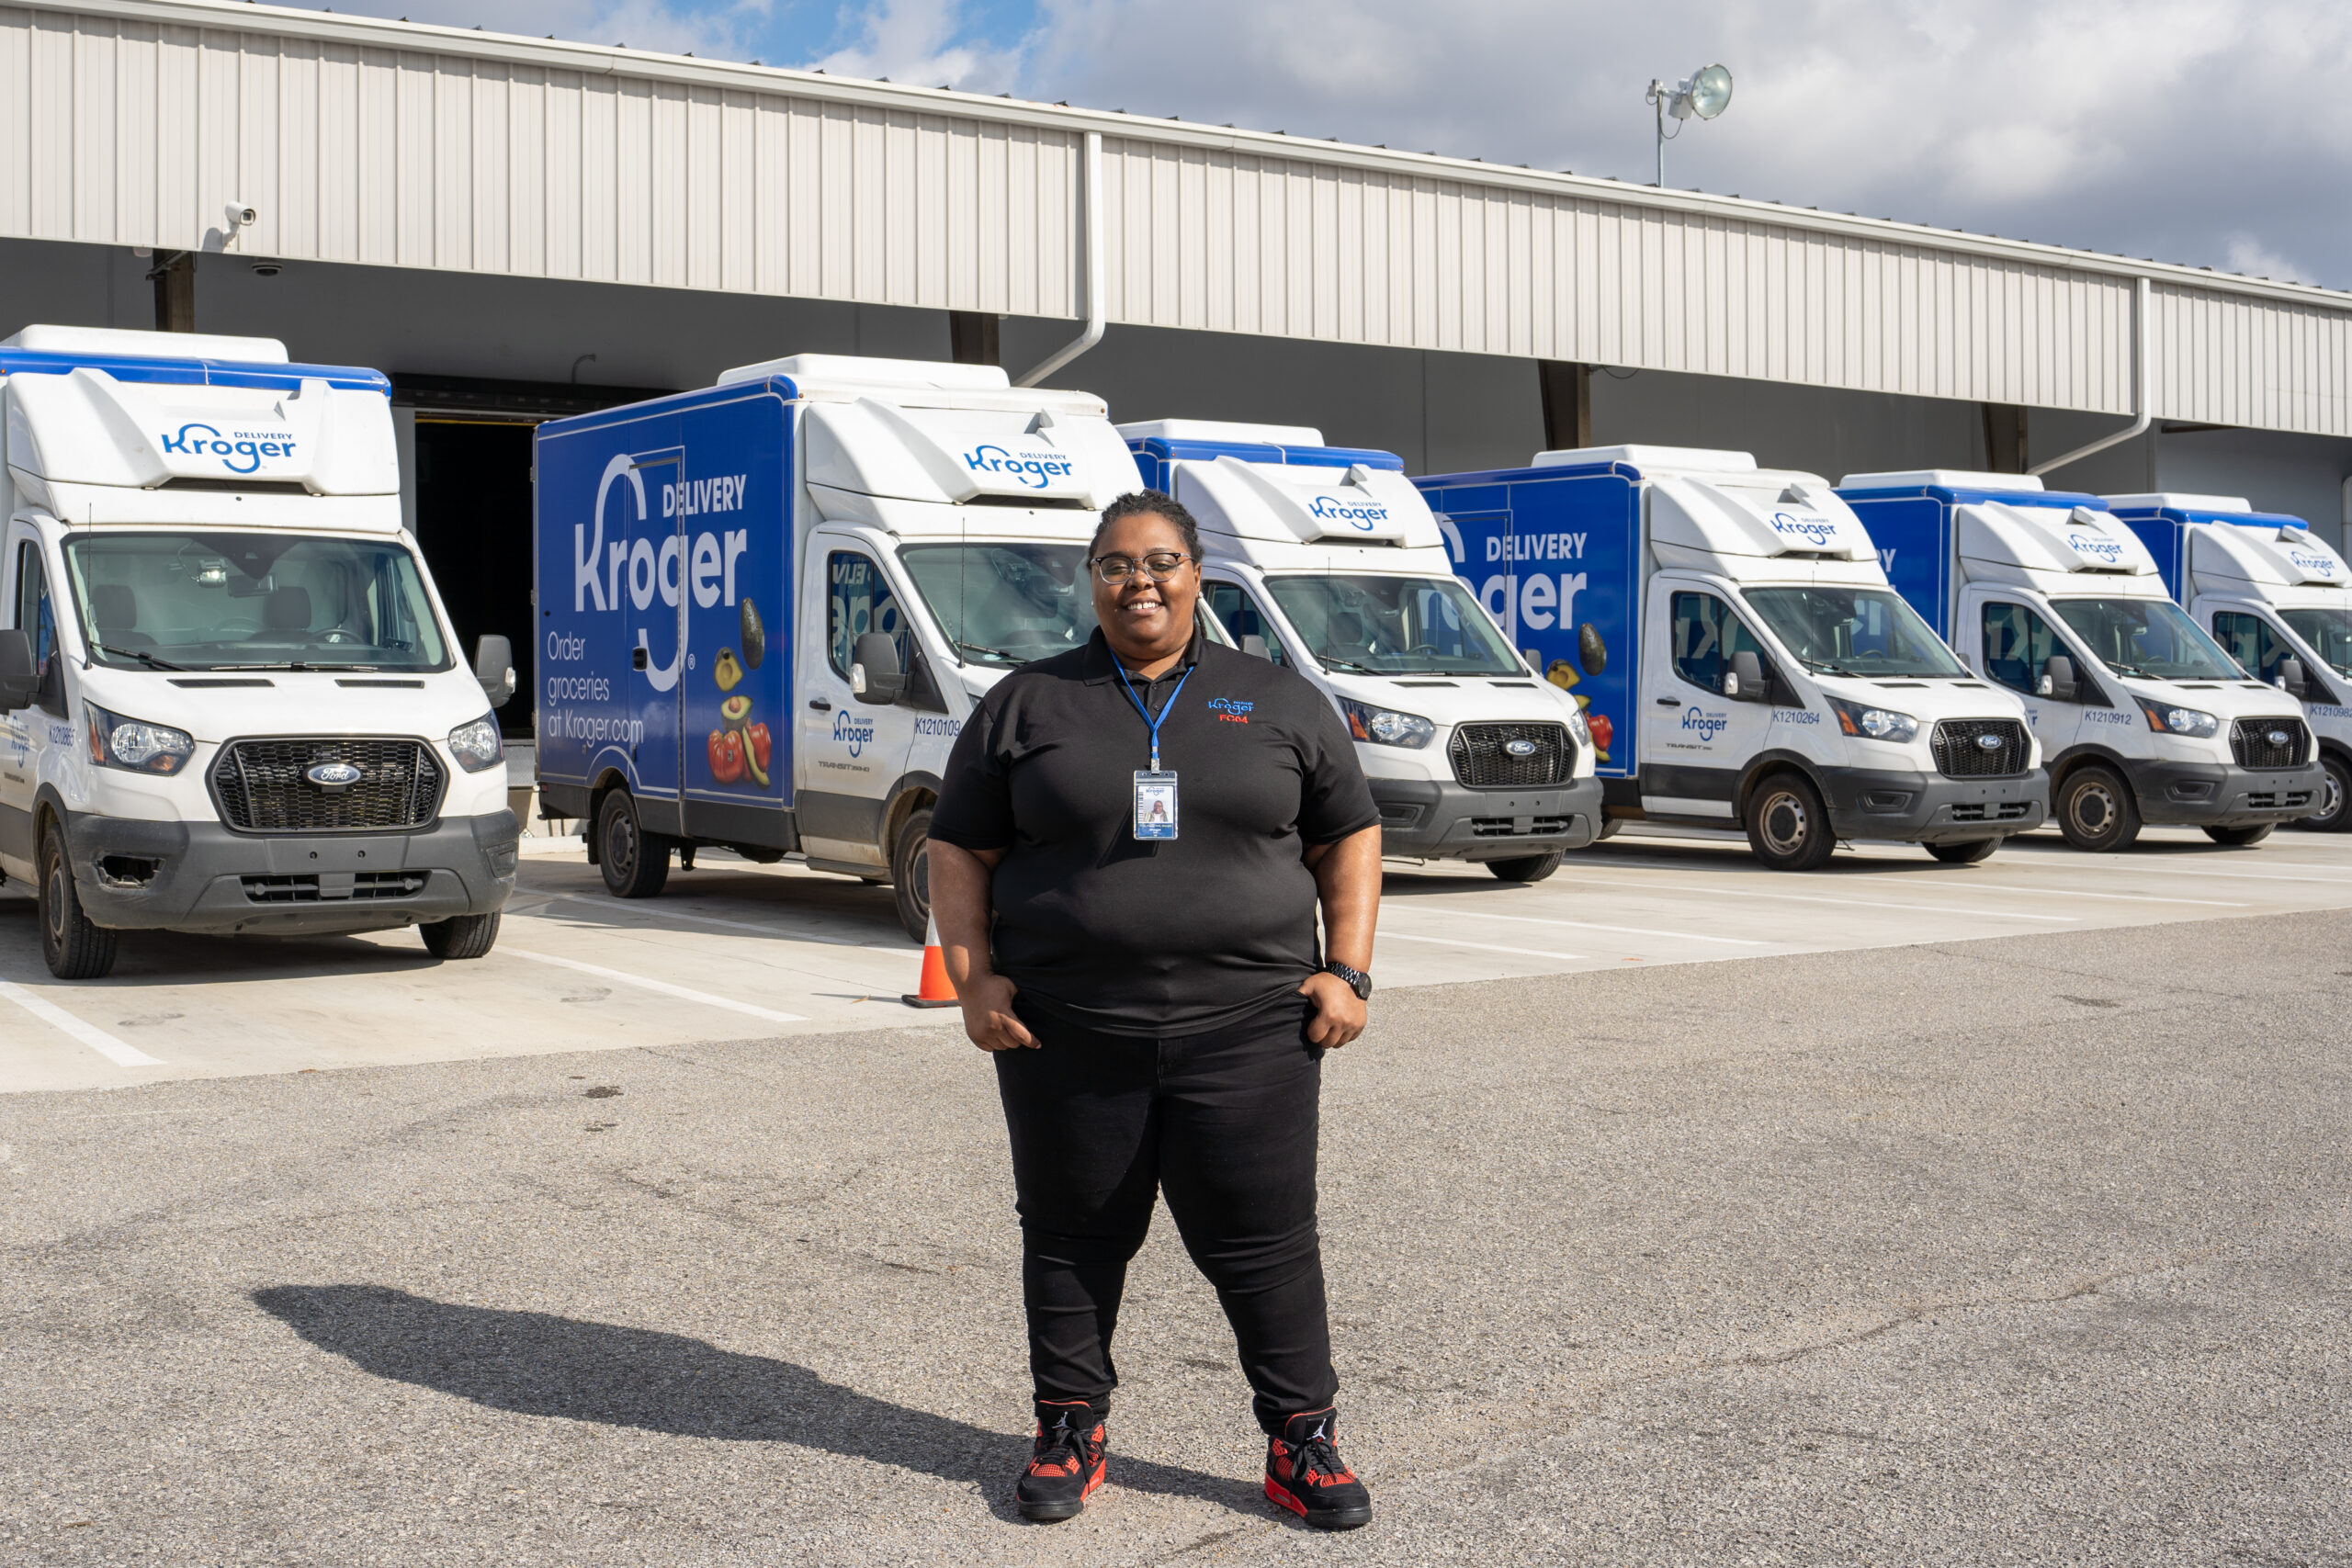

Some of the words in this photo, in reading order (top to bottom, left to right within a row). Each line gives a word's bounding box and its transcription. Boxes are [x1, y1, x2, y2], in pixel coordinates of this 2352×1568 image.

[161, 423, 297, 474] Kroger
[233, 431, 293, 440] DELIVERY
[963, 445, 1073, 489] Kroger
[1019, 452, 1067, 460] DELIVERY
[662, 474, 747, 518] DELIVERY
[1308, 496, 1388, 531] Kroger
[1770, 513, 1837, 546] Kroger
[1486, 532, 1588, 562] DELIVERY
[2066, 534, 2123, 563] Kroger
[574, 453, 748, 692] Kroger
[548, 631, 585, 660] Order
[548, 671, 610, 706] groceries
[1207, 697, 1255, 715] Kroger
[1219, 714, 1249, 724] FC04
[1773, 710, 1820, 725] K1210264
[2085, 710, 2132, 725] K1210912
[548, 710, 562, 738] at
[565, 709, 644, 749] Kroger.com
[833, 710, 874, 758] Kroger
[854, 717, 874, 726] DELIVERY
[915, 717, 961, 737] K1210109
[1682, 706, 1727, 741] Kroger
